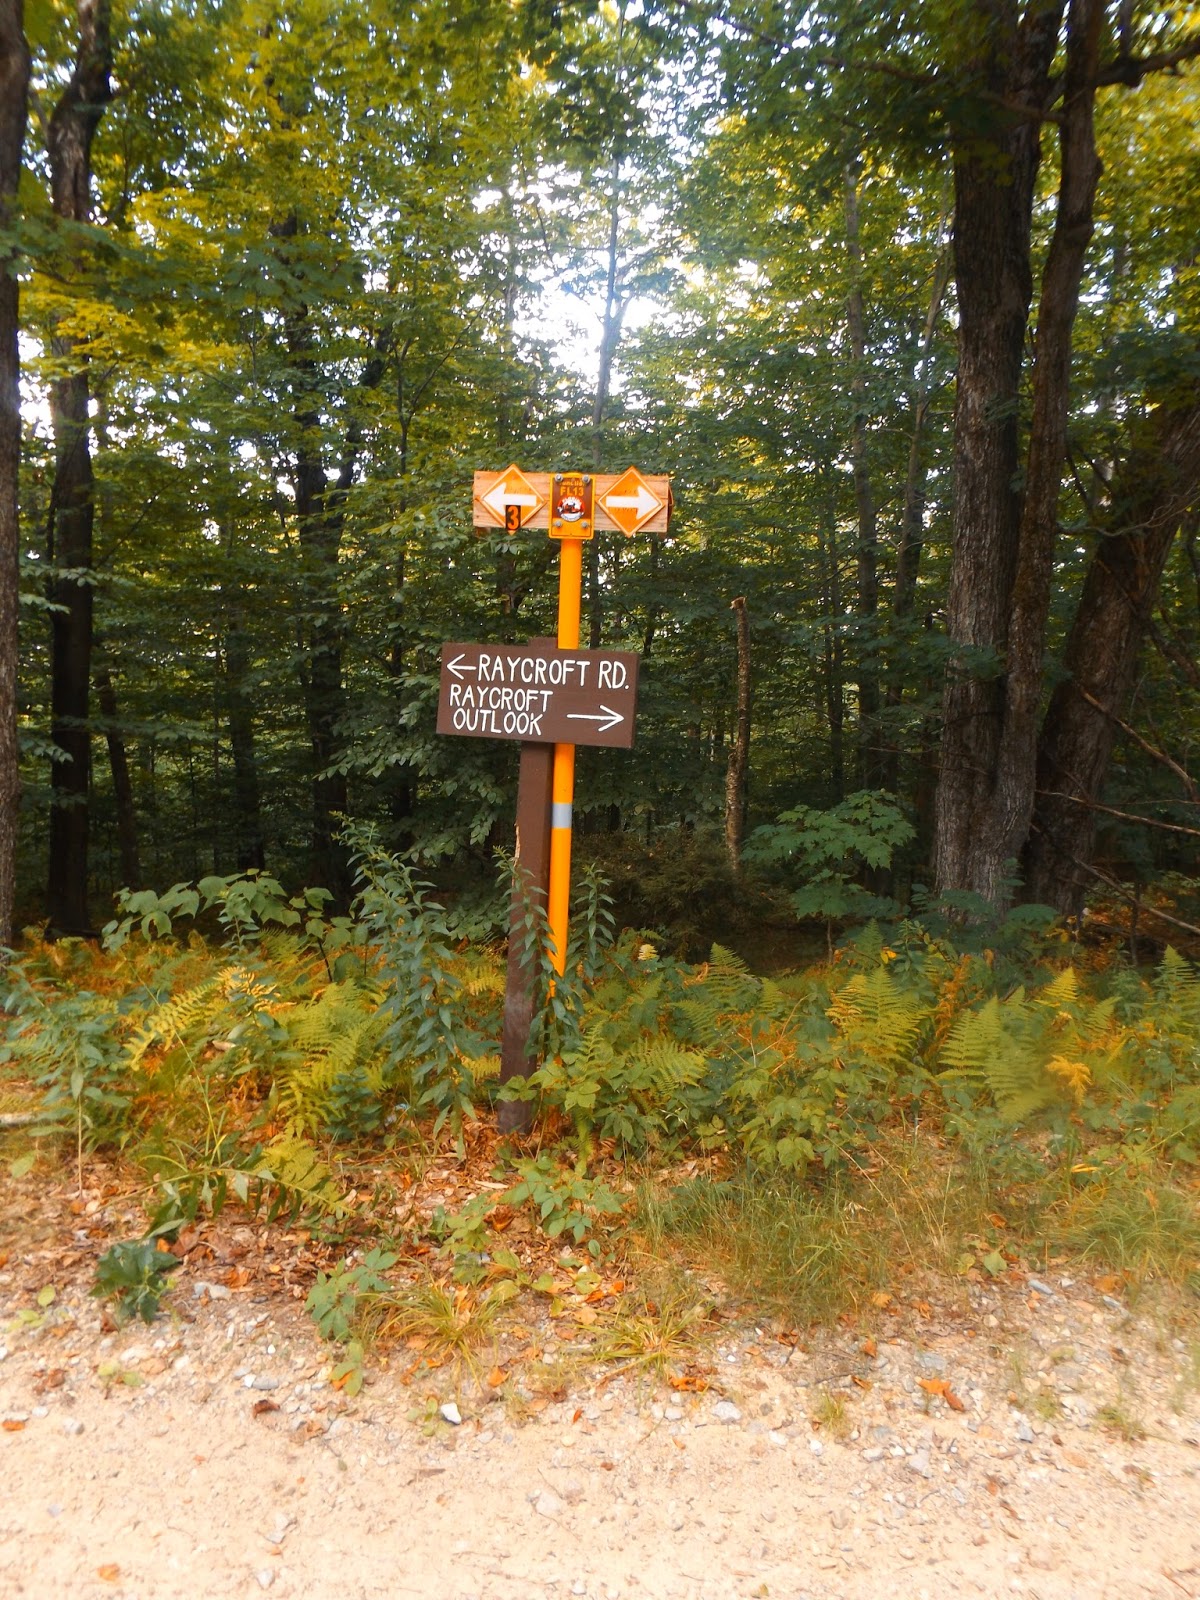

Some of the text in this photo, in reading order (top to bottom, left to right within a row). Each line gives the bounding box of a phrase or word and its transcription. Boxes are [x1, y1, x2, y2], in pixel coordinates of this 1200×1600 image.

[507, 505, 519, 530] 3
[477, 653, 630, 690] RAYCROFT RD.
[449, 683, 554, 713] RAYCROFT
[452, 707, 543, 736] OUTLOOK
